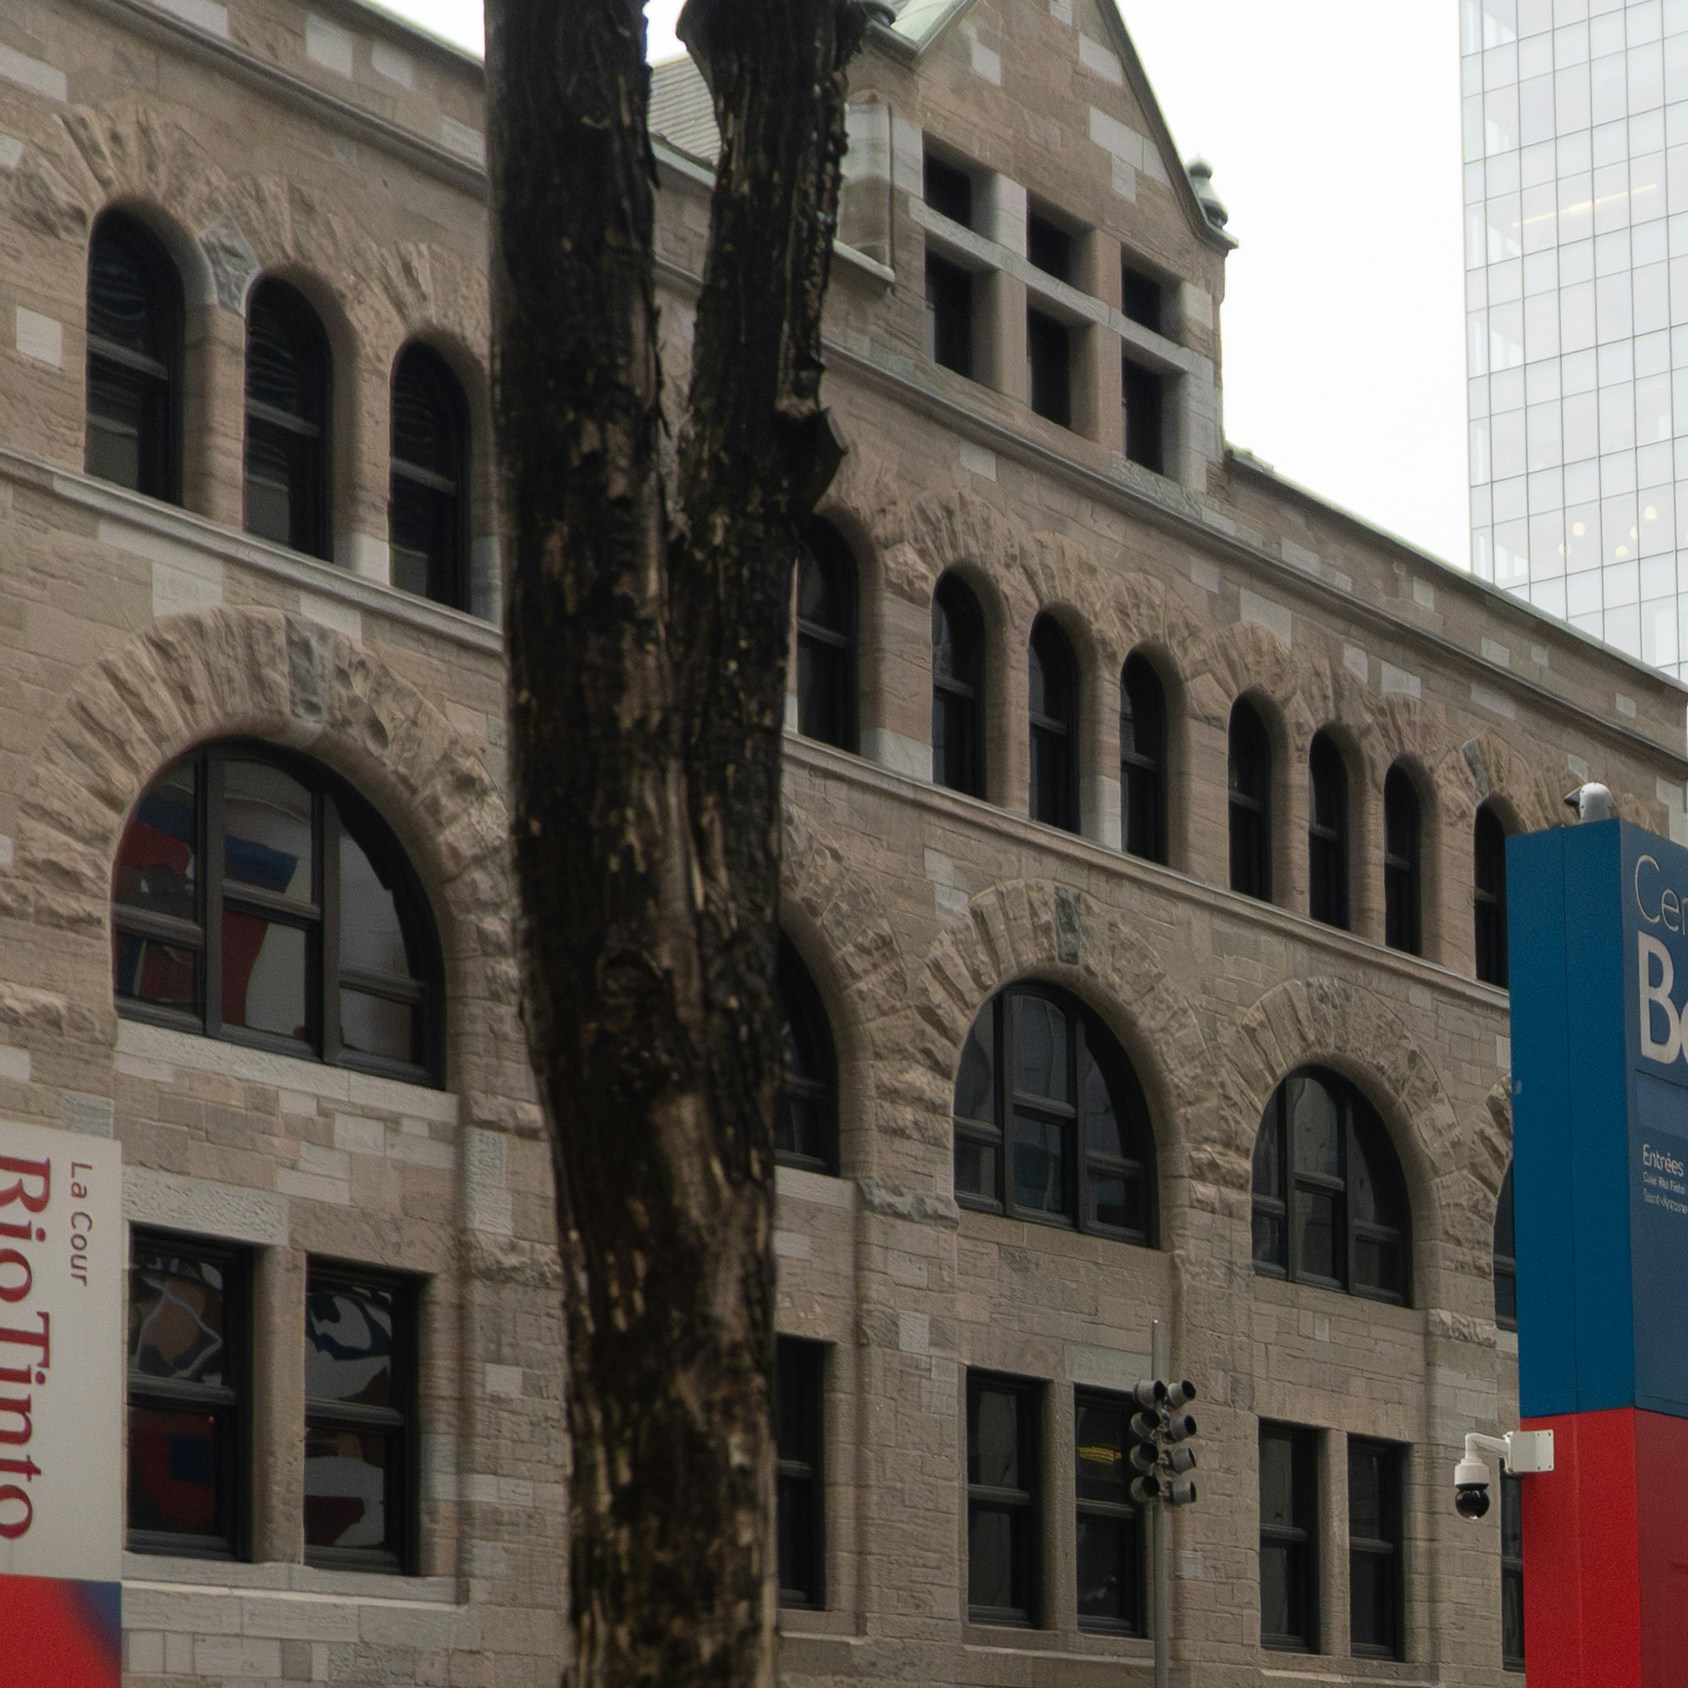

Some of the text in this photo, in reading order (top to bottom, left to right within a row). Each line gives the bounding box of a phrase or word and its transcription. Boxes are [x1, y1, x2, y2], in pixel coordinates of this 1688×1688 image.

[70, 1161, 93, 1287] La Cour
[1642, 1144, 1685, 1178] Entrées
[0, 1155, 51, 1540] Rio Tinto
